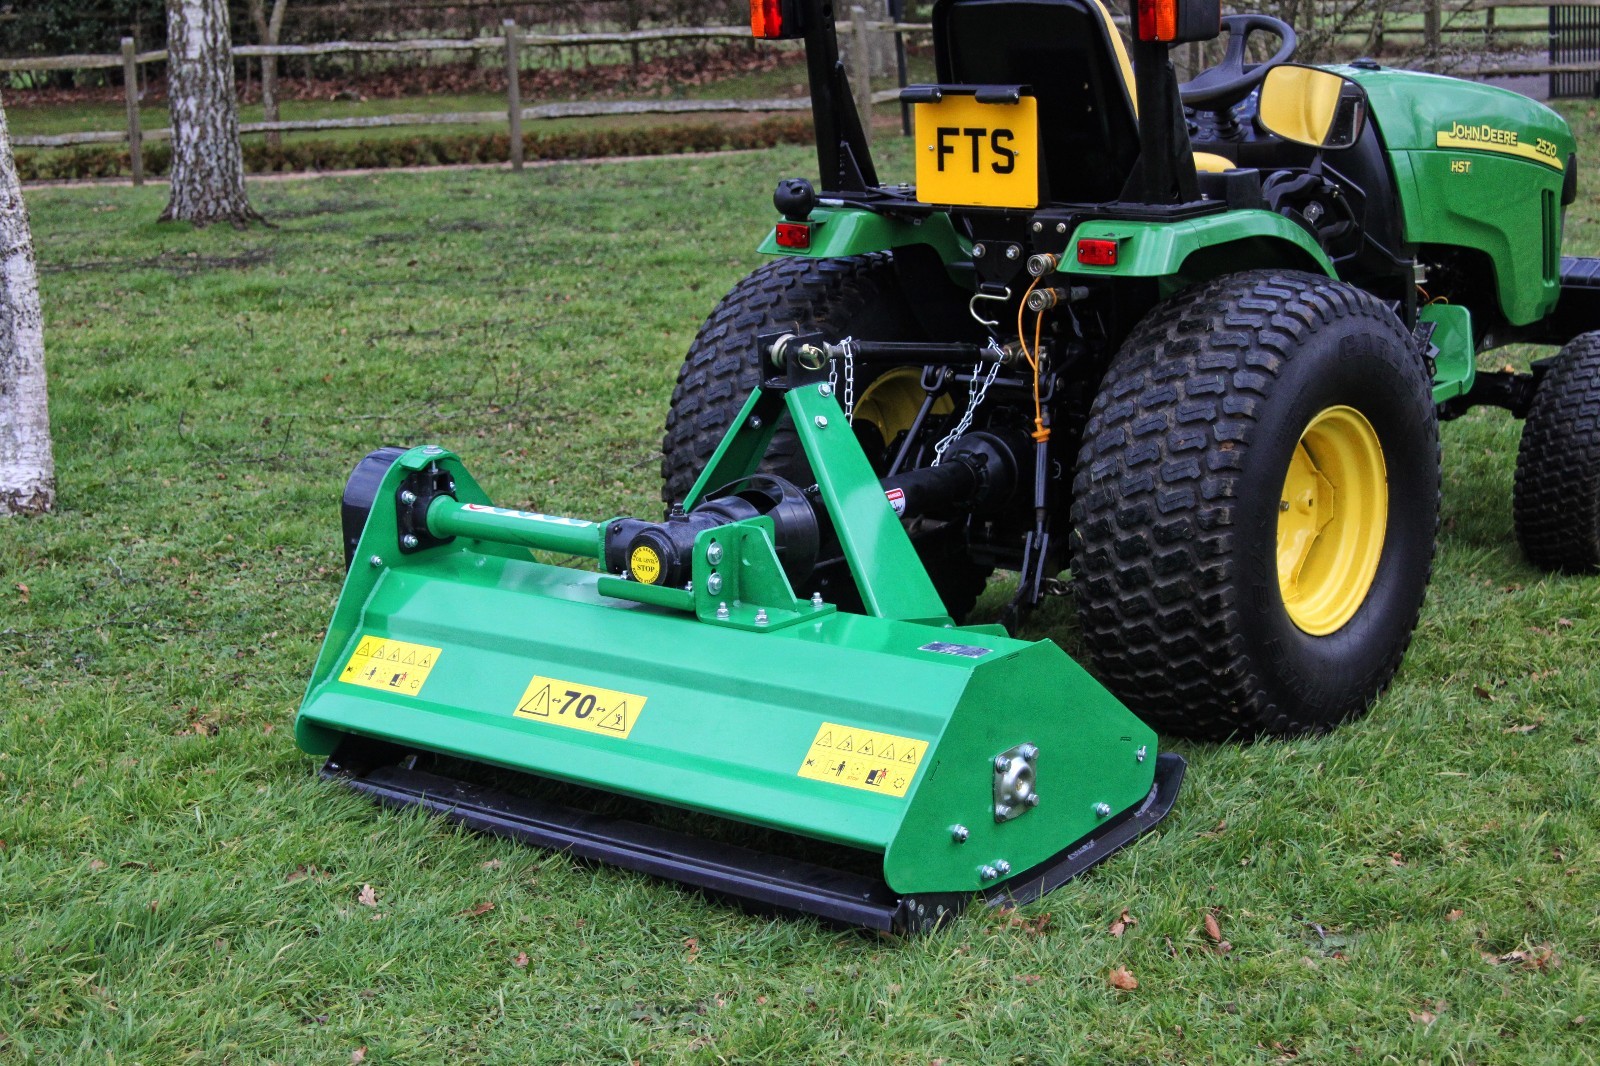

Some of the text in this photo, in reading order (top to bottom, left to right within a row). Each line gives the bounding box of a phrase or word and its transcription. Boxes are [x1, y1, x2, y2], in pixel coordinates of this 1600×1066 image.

[936, 127, 1015, 175] FTS
[1448, 121, 1557, 158] JOHN DEERE 2520
[1451, 160, 1471, 173] HST
[637, 564, 656, 572] STOP
[558, 690, 597, 719] 70
